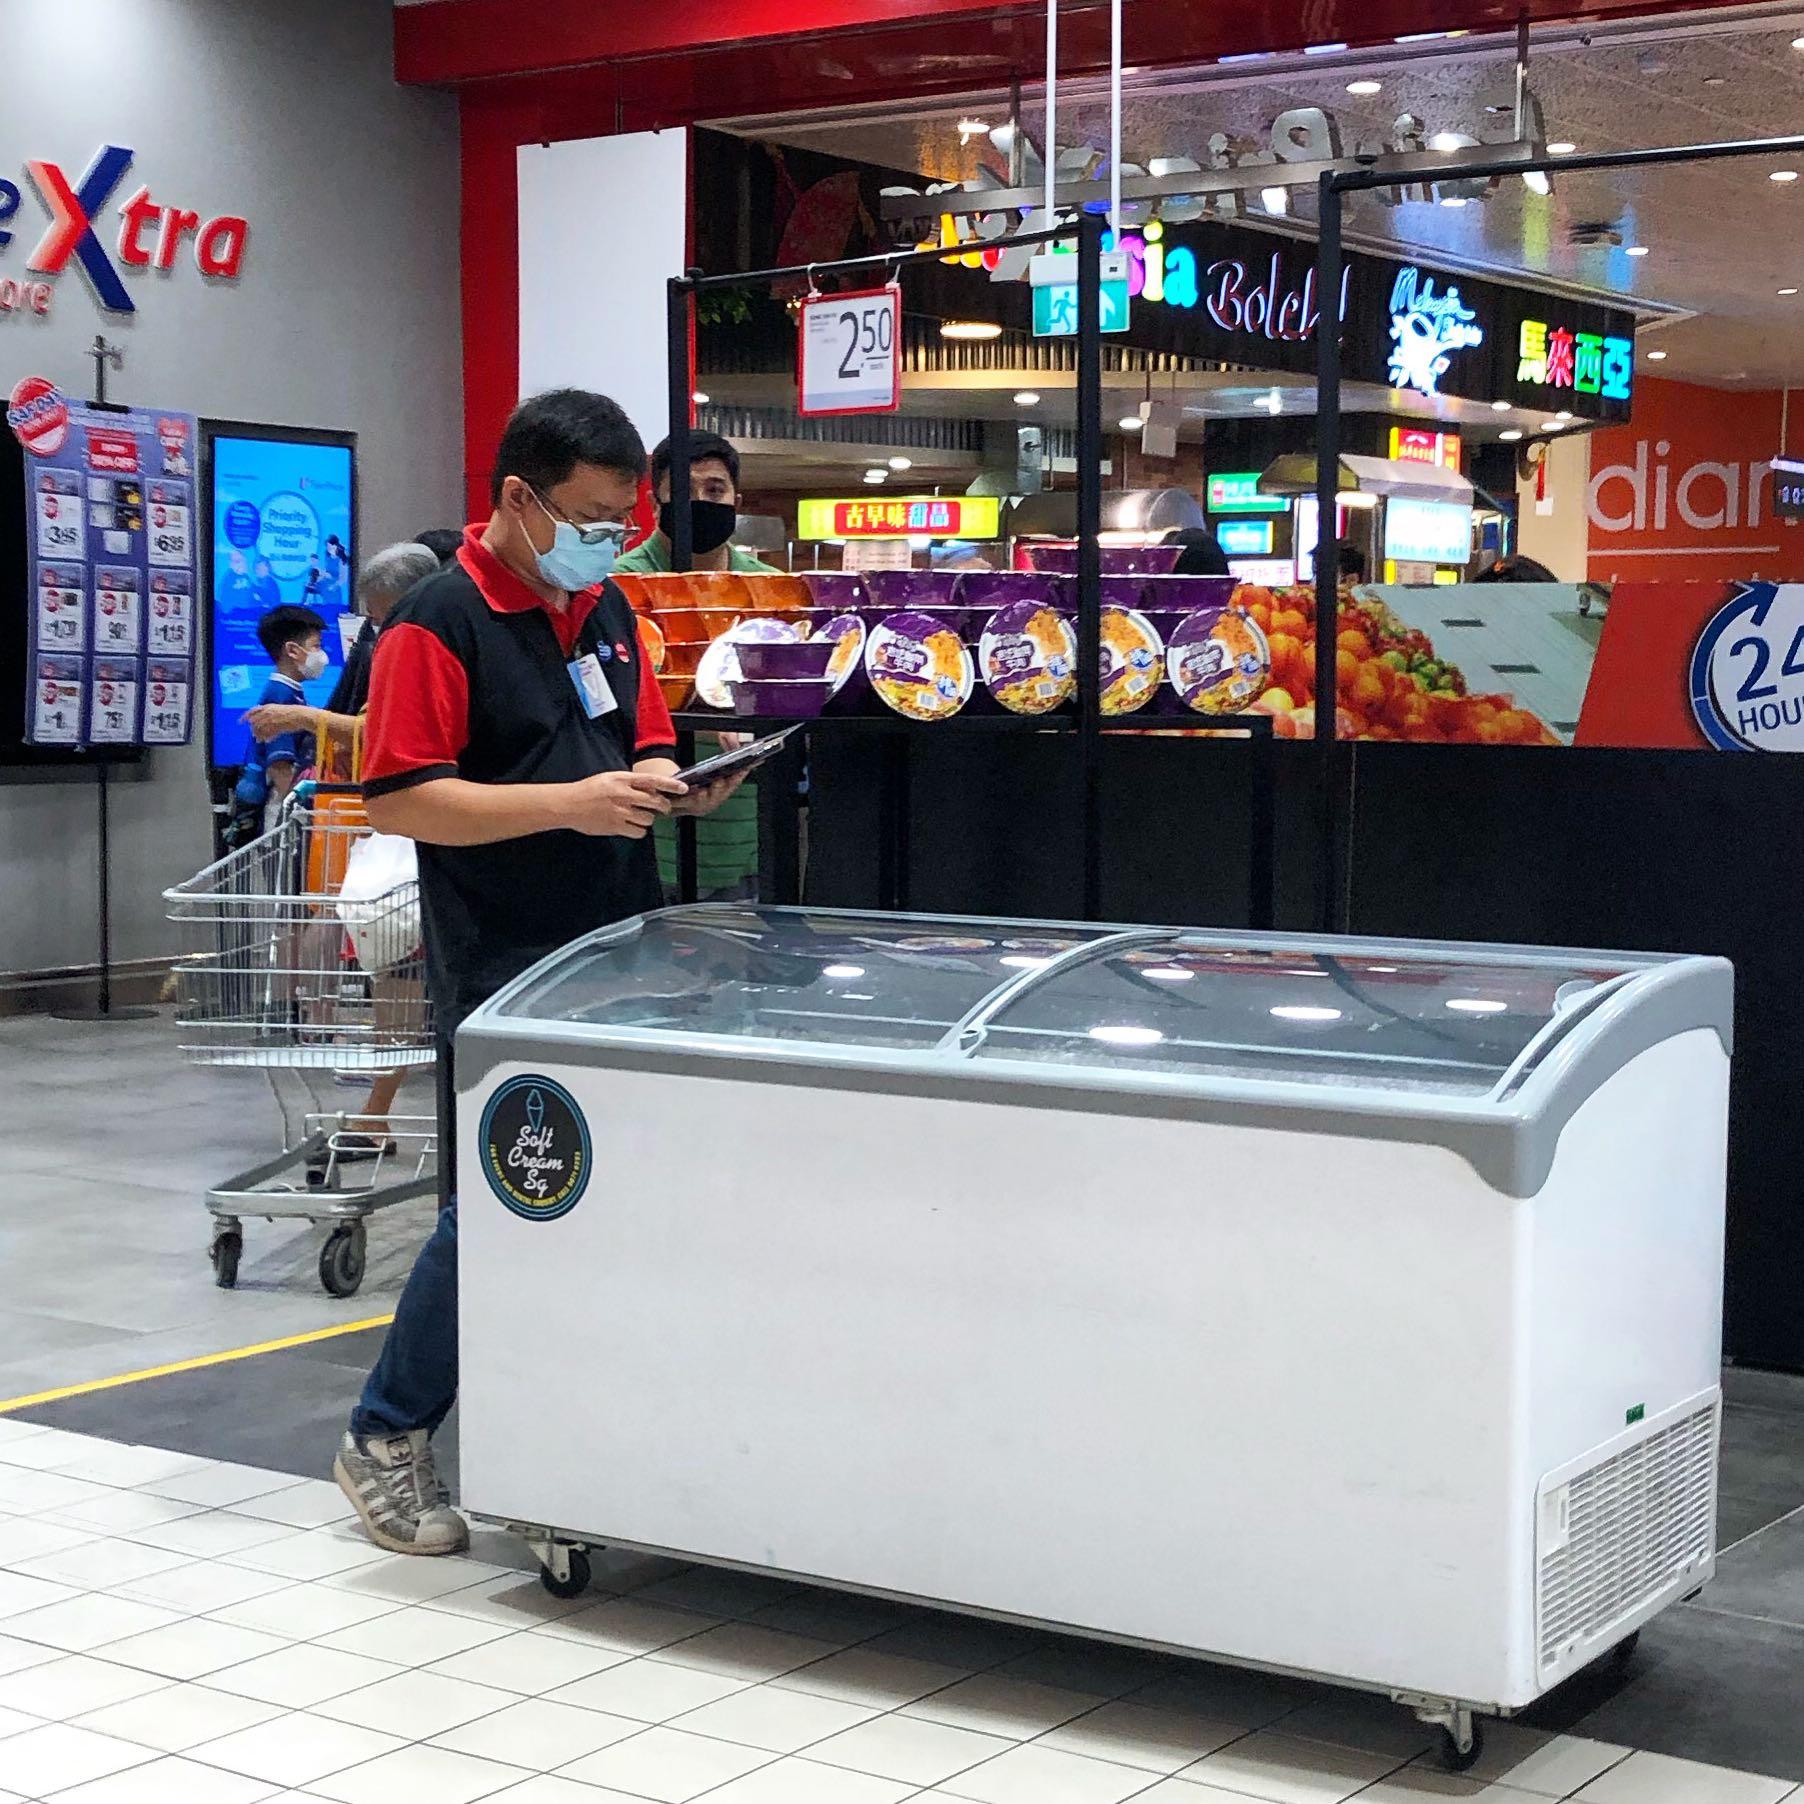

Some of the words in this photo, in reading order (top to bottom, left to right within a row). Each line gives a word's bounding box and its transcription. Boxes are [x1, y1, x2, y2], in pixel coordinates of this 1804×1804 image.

[846, 503, 949, 529] 古早味甜品
[1738, 695, 1804, 736] HOU
[516, 1125, 554, 1156] Soft
[507, 1146, 565, 1171] Cream
